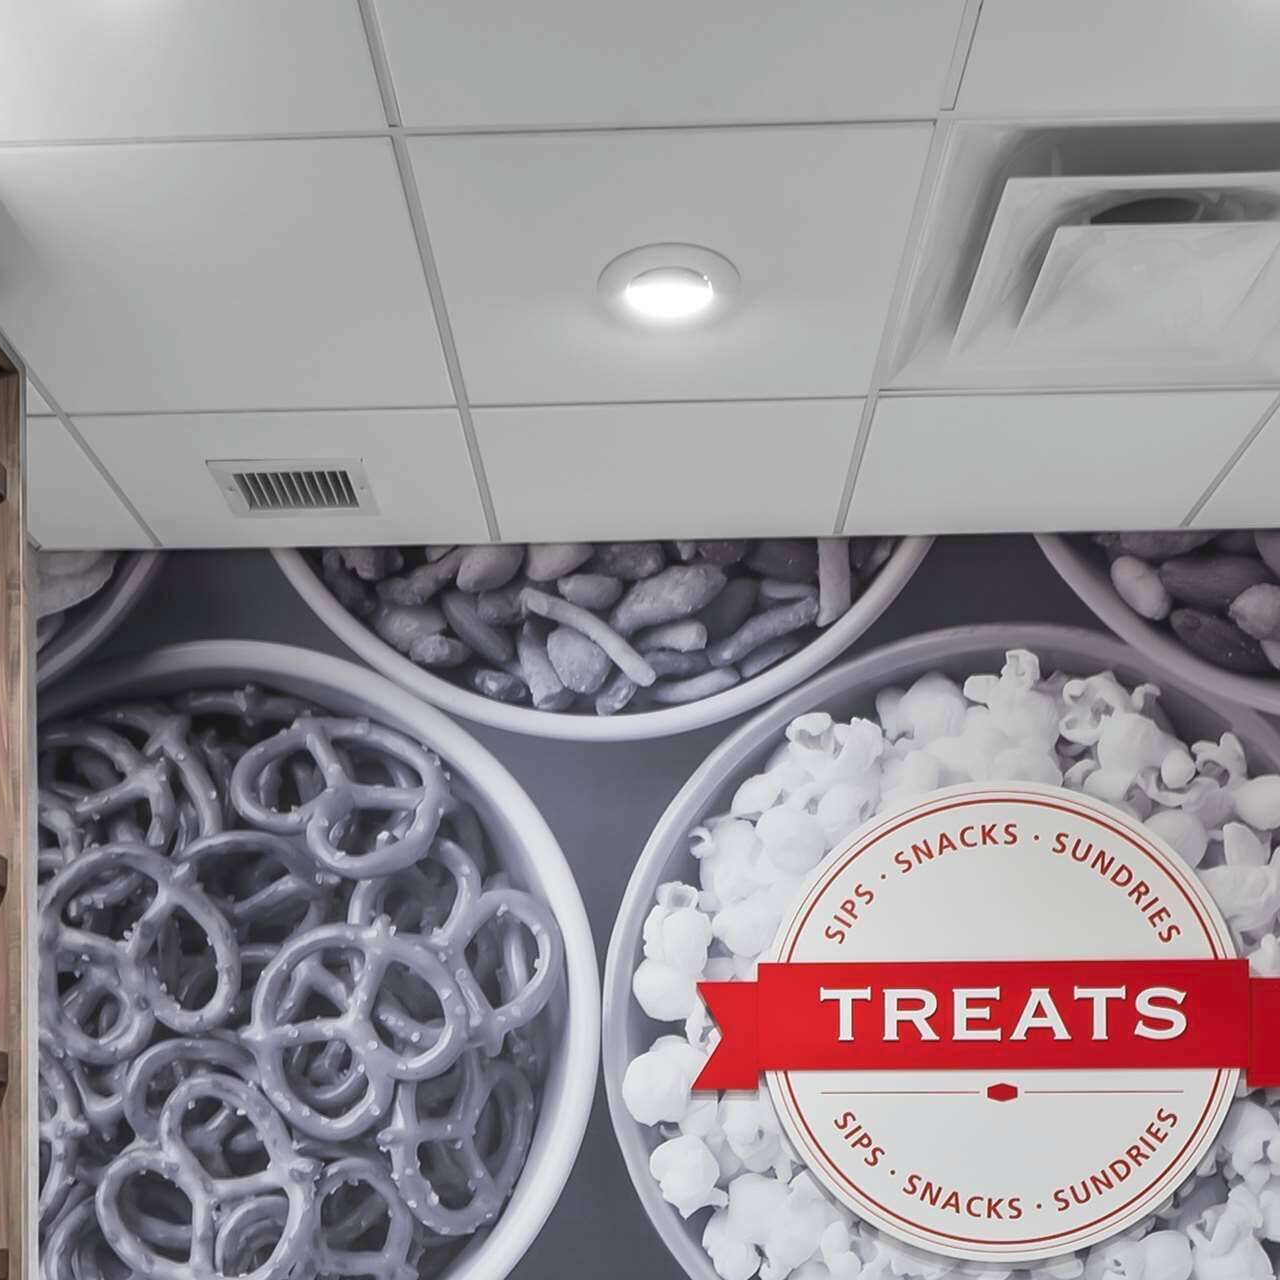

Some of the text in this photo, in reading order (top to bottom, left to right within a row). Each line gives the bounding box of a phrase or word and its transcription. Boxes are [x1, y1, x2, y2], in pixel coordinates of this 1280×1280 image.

[825, 822, 1182, 946] SIPS SNACKS SUNDRIES
[819, 984, 1189, 1042] TREATS
[832, 1107, 1180, 1220] SIPS SNACKS SUNDRIES
